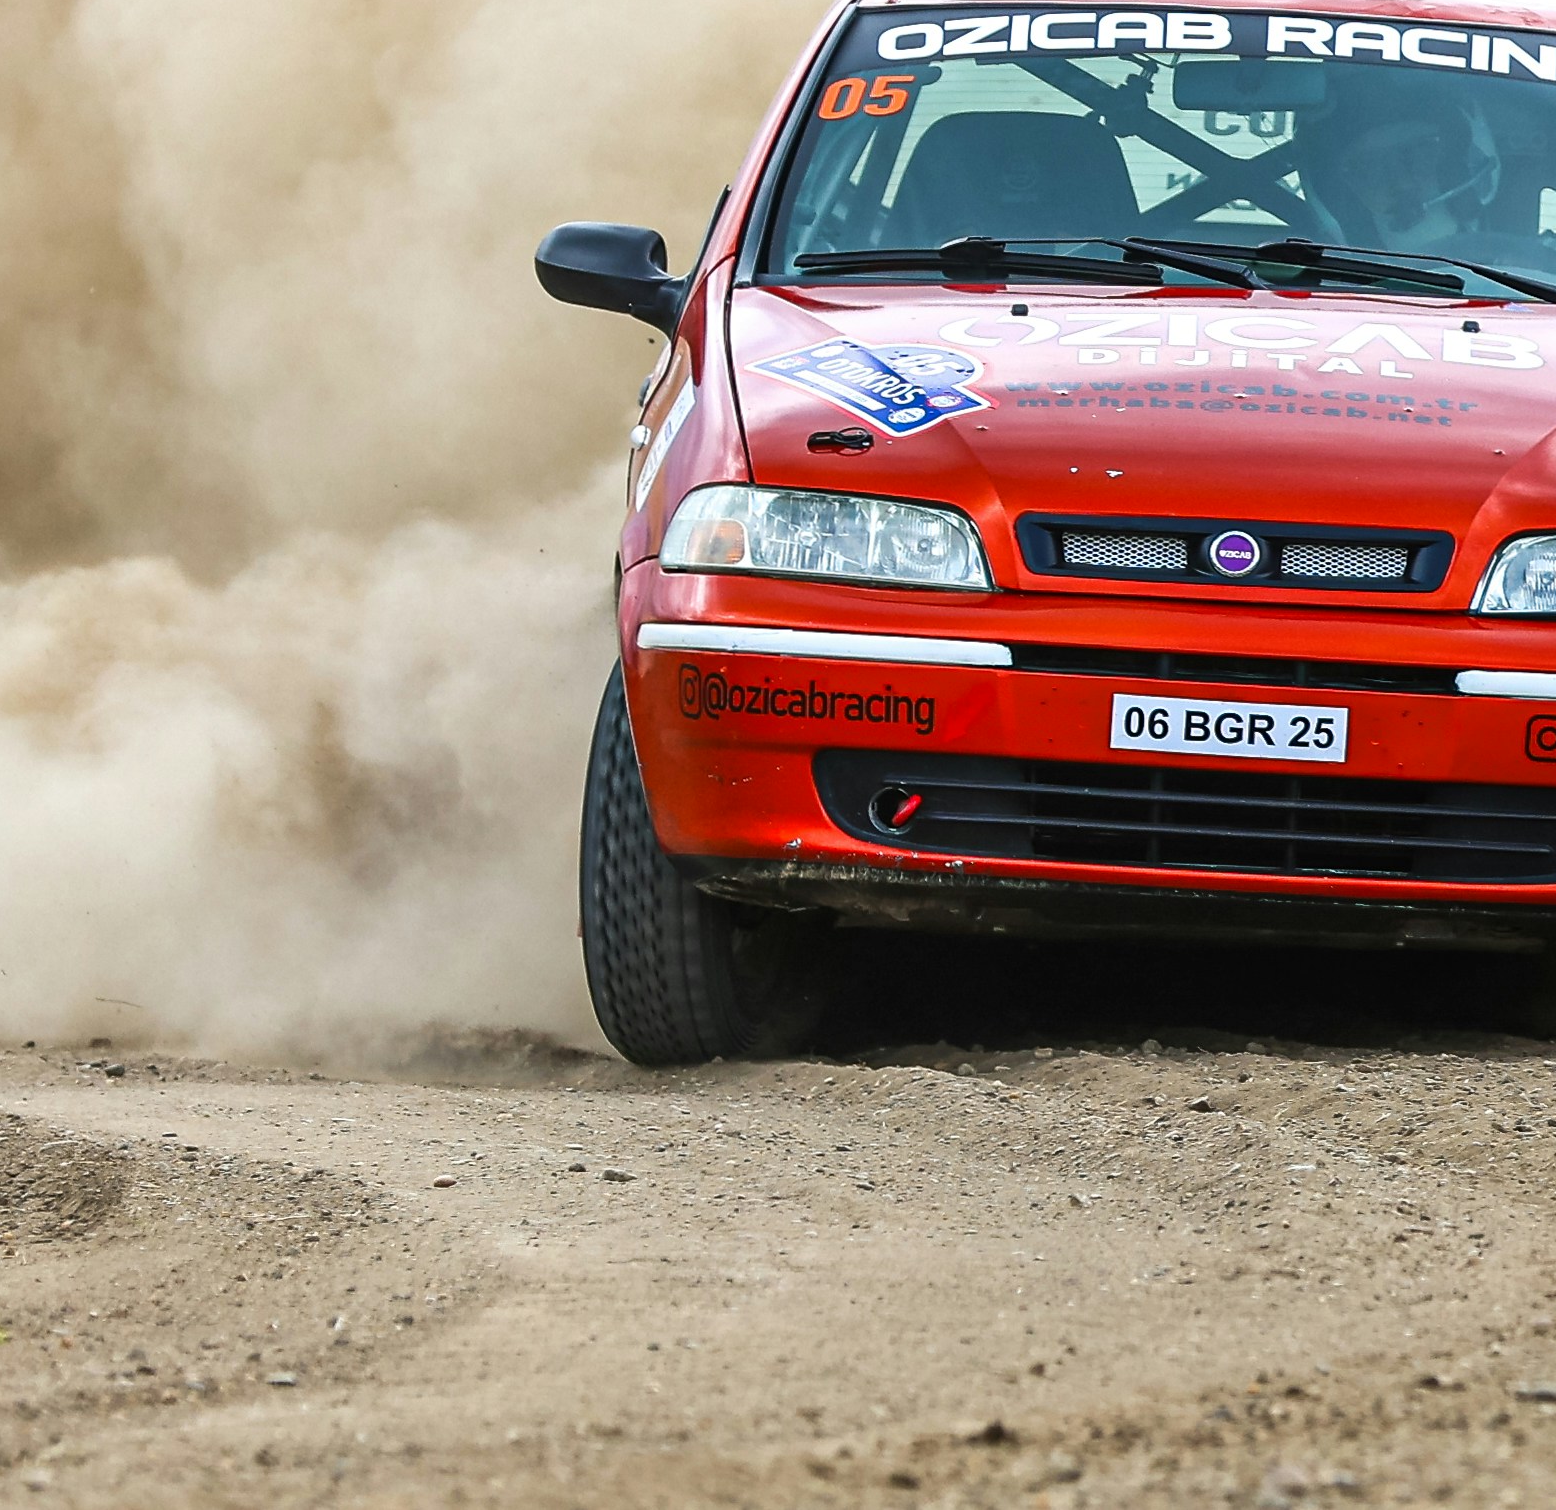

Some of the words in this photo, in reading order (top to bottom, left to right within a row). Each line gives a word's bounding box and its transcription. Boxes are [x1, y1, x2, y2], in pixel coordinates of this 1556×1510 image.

[877, 12, 1233, 60] OZICAB
[818, 75, 918, 120] 05
[938, 313, 1546, 370] OZICAB
[816, 358, 927, 405] OTOKROS
[1004, 380, 1479, 412] www.ozicab.com.tr
[1016, 395, 1453, 427] merhaba@ozicab.net
[1218, 549, 1252, 560] OZICAB
[703, 672, 936, 736] @ozicabracing
[1124, 706, 1170, 740] 06
[1183, 709, 1276, 746] BGR
[1287, 716, 1335, 749] 25
